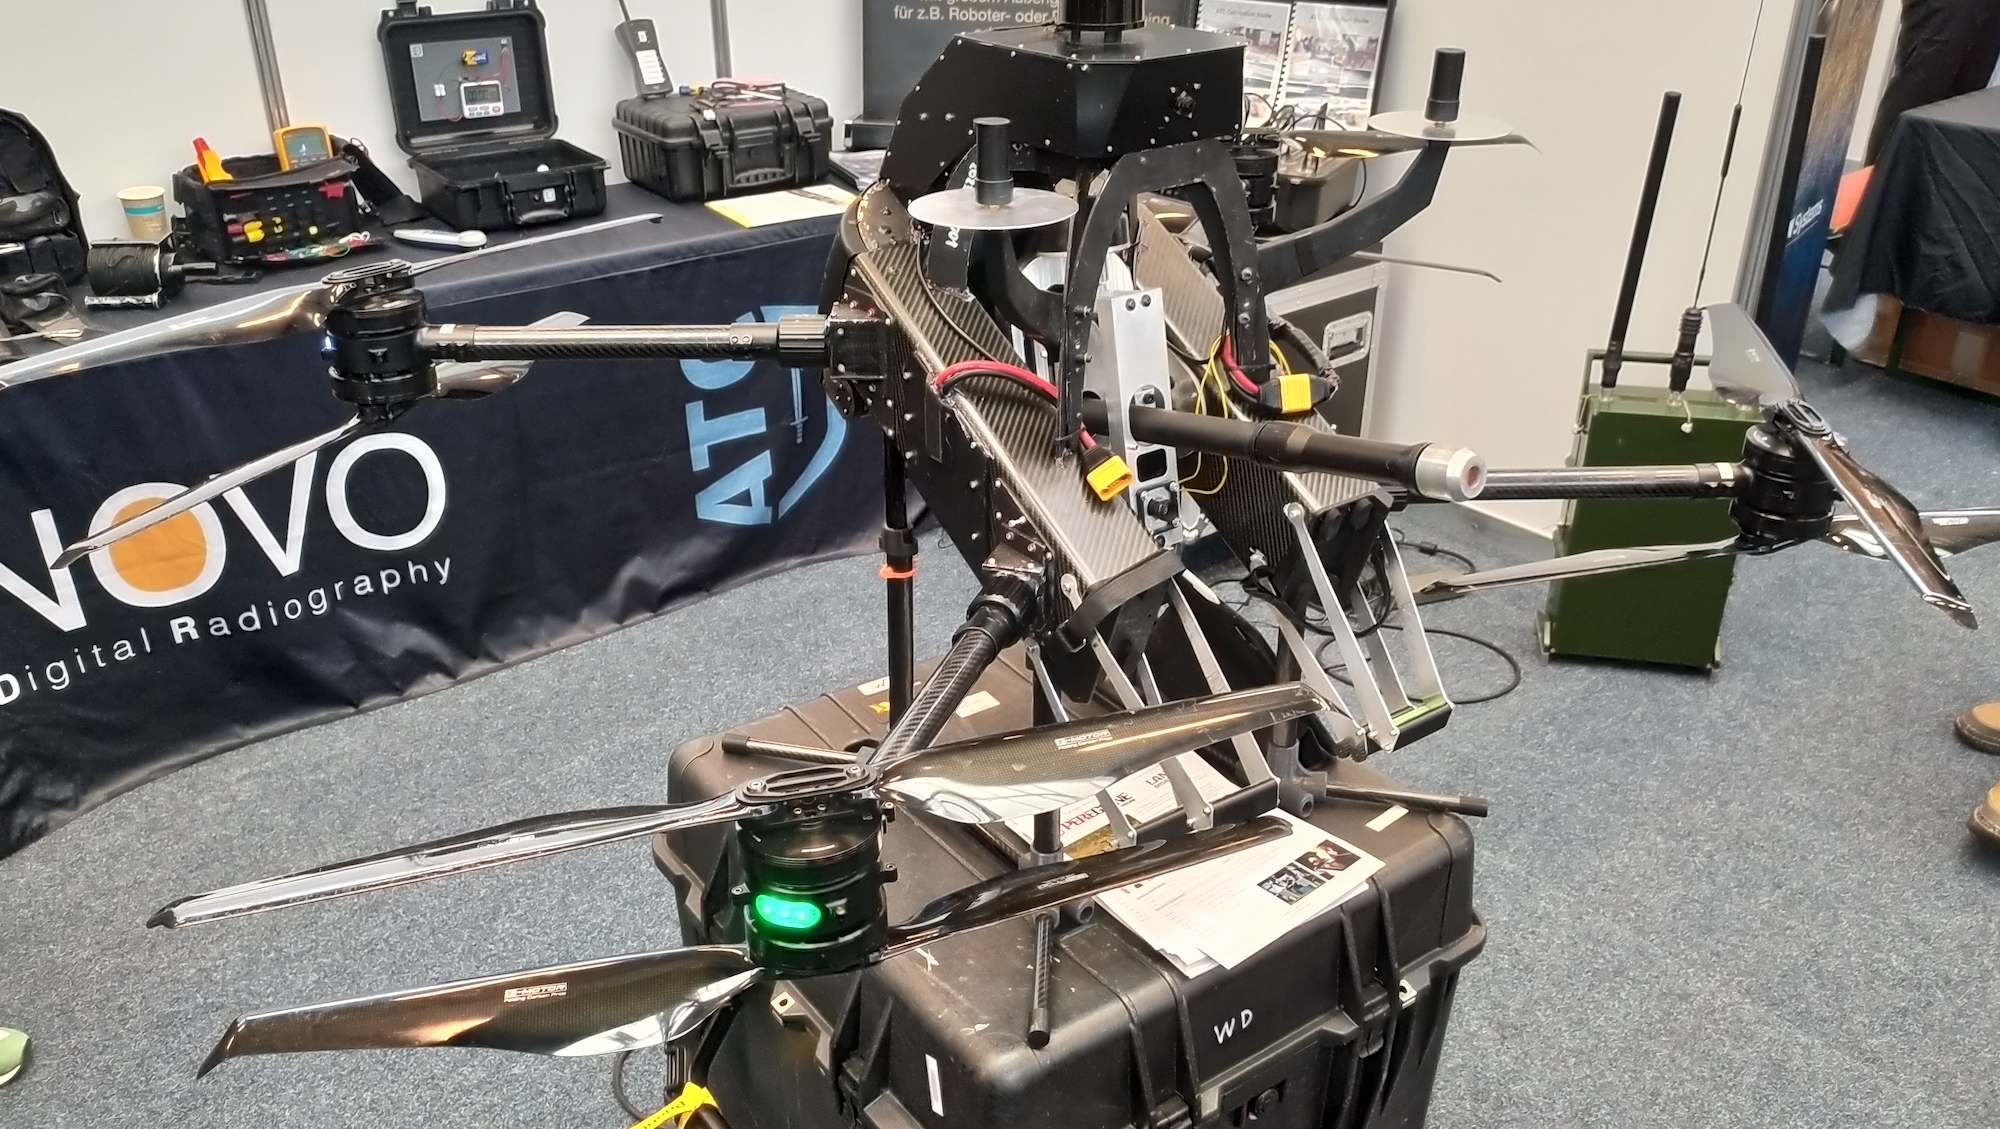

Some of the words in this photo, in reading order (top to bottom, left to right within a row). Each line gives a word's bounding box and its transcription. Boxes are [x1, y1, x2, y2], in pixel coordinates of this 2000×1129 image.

[894, 5, 914, 19] für
[948, 7, 1012, 22] Roboter-
[1015, 9, 1049, 23] oder
[0, 627, 151, 703] Digital
[169, 556, 452, 645] Radiography
